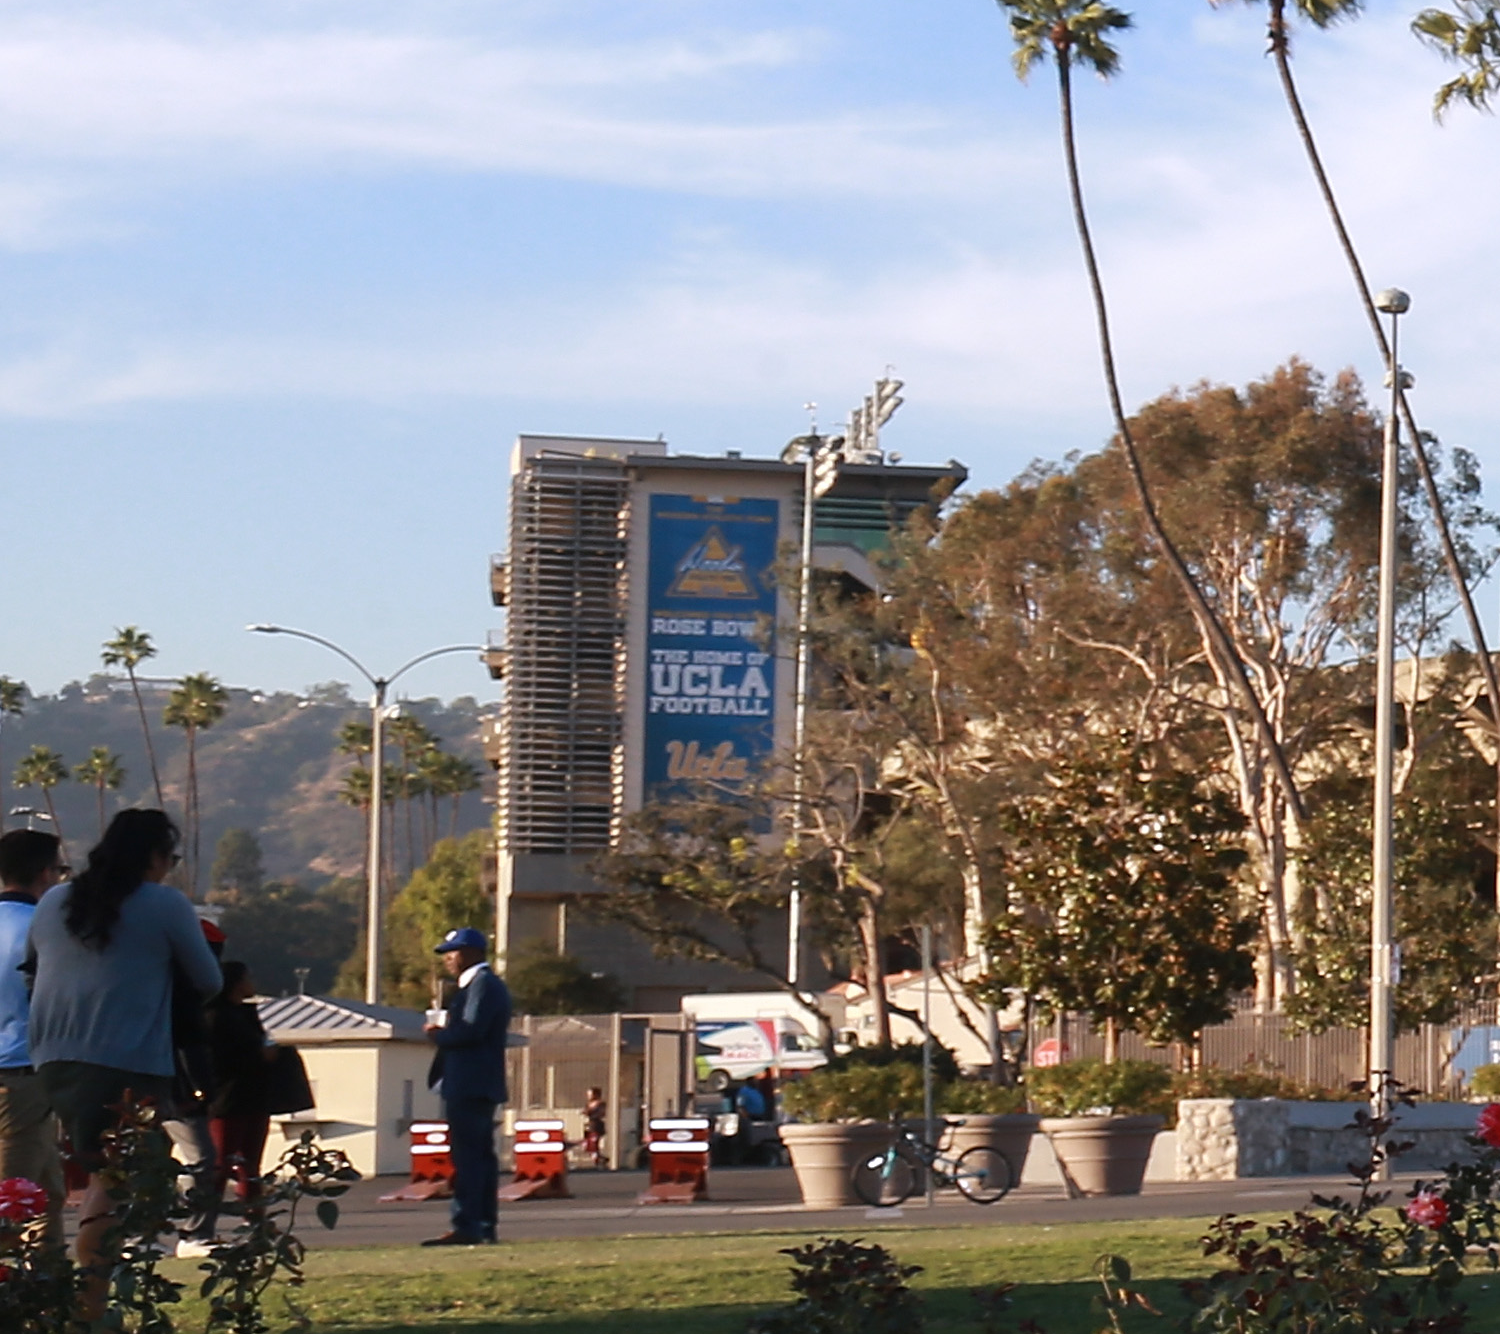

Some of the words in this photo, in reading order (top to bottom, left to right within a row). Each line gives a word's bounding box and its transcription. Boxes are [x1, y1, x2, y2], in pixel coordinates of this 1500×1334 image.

[652, 618, 706, 635] ROSE
[711, 620, 771, 637] BOW
[651, 650, 689, 663] THE
[693, 650, 743, 665] HOME
[746, 652, 771, 665] OF
[650, 664, 770, 697] UCLA
[649, 697, 769, 716] FOOTBALL
